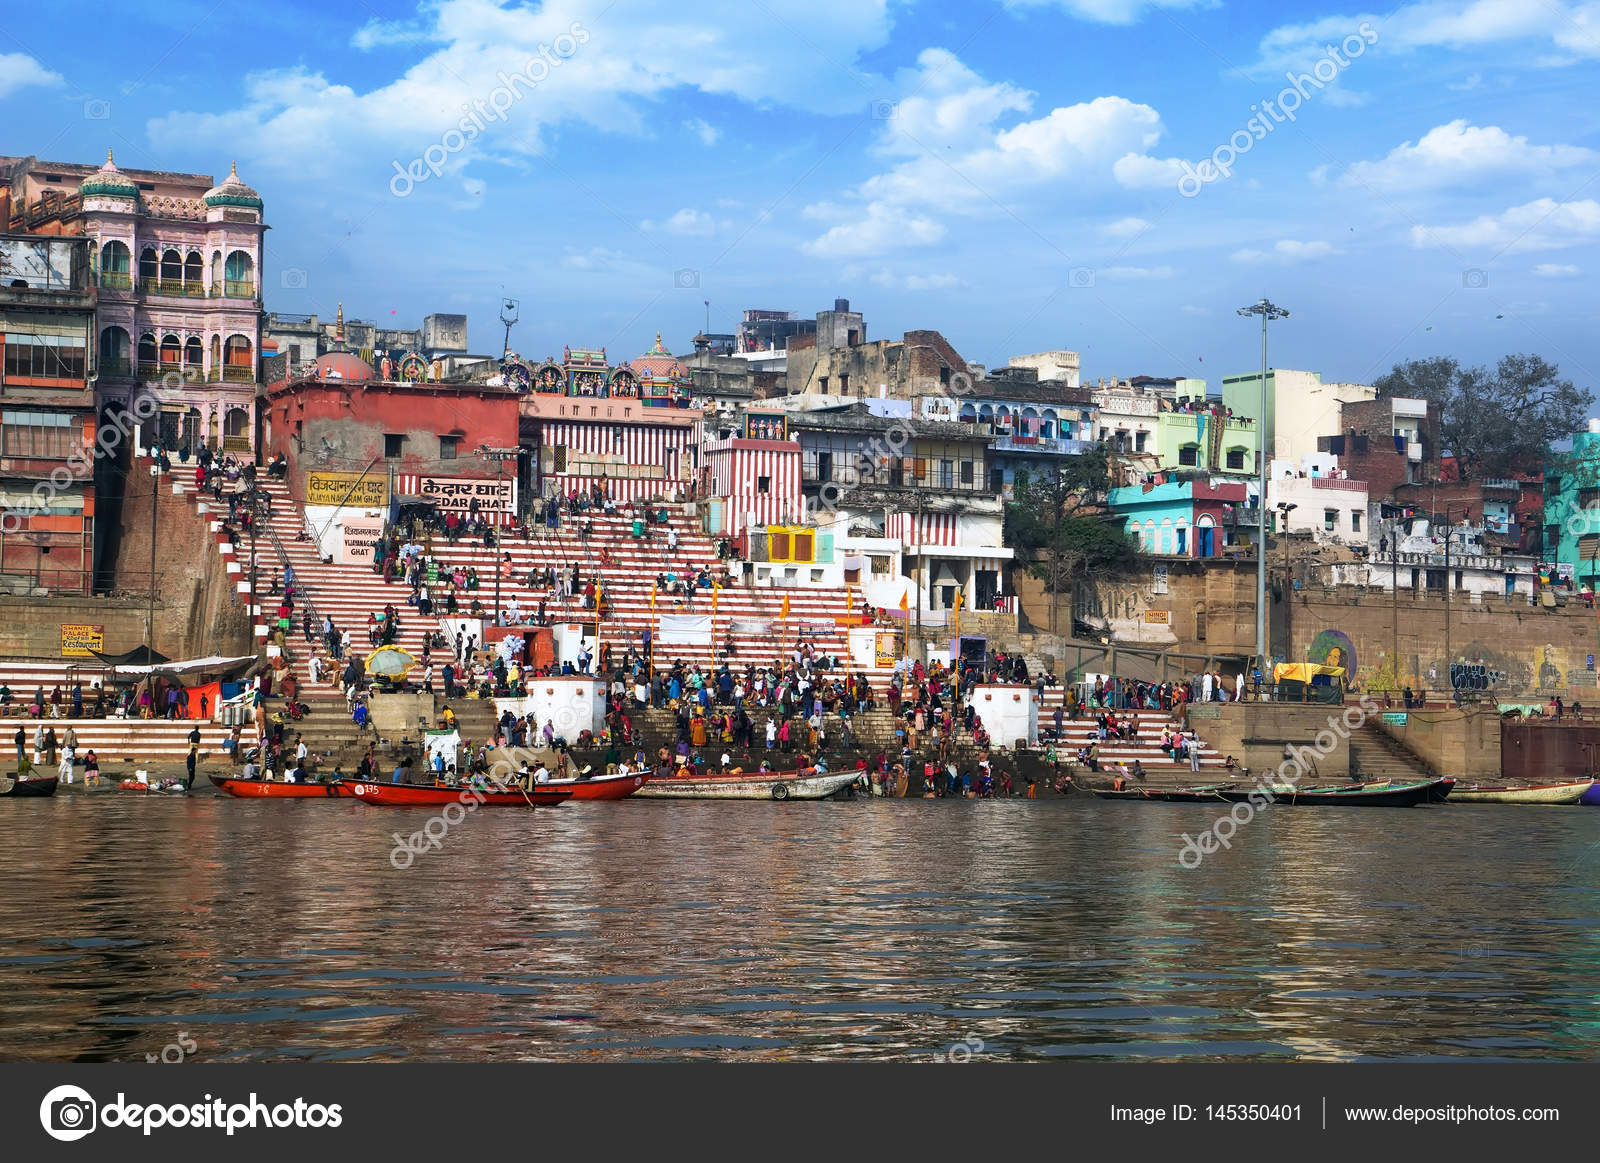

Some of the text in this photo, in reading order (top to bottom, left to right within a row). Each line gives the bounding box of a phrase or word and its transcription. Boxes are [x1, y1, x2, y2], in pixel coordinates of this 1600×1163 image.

[423, 479, 509, 497] केदार घाट
[364, 495, 382, 504] GHAT
[434, 497, 468, 508] EDAR
[350, 548, 369, 556] GHAT
